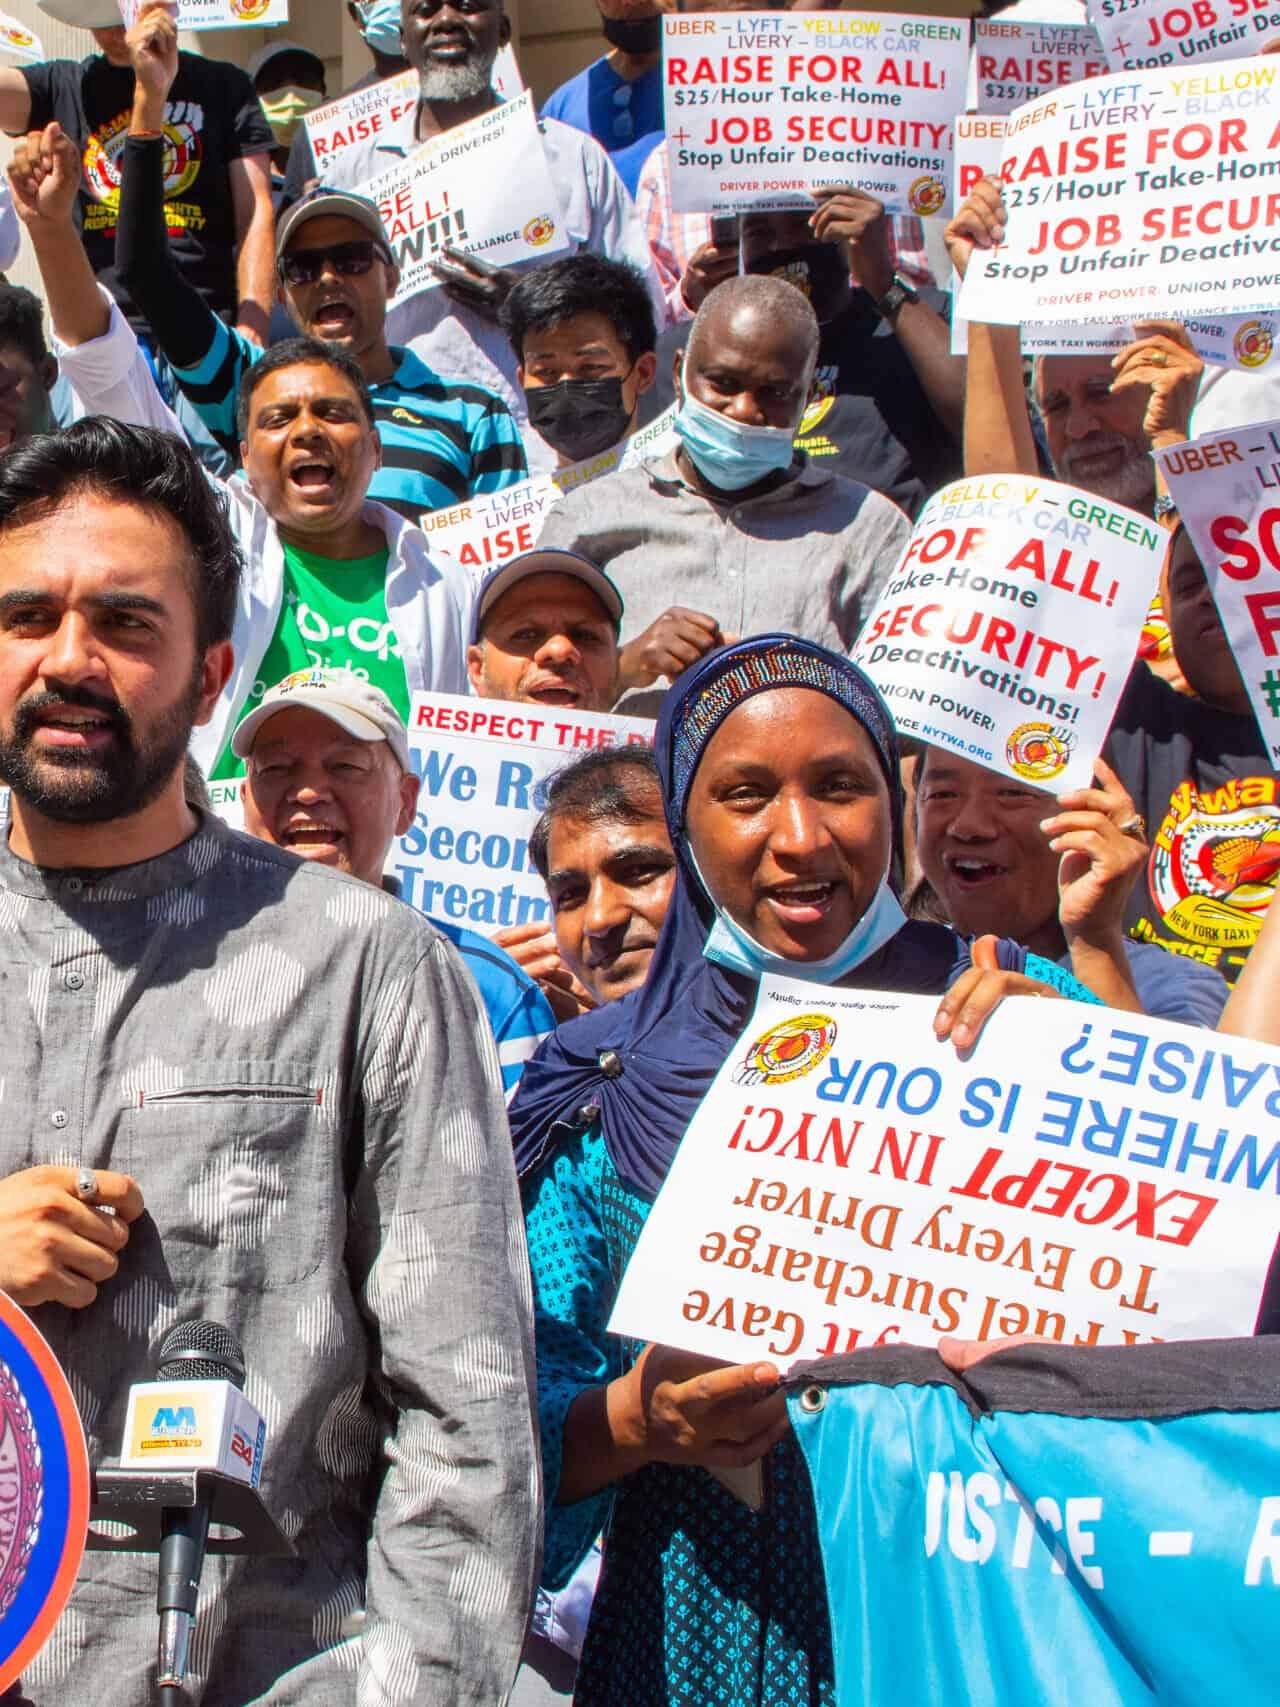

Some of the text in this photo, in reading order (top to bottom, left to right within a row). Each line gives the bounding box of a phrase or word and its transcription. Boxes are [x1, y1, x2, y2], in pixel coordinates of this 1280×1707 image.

[665, 19, 961, 40] UBER LYFT YELLOW GREEN
[977, 23, 1081, 40] UBER LYFT
[1147, 0, 1218, 47] JOB
[1179, 23, 1248, 58] Unfair
[728, 34, 920, 53] LIVERY BLACK CAR
[1032, 42, 1090, 56] LIVERY
[668, 55, 945, 90] RAISE FOR ALL!
[979, 56, 1072, 84] RAISE
[1083, 84, 1143, 108] LYFT
[1171, 67, 1278, 97] YELLOW
[307, 89, 381, 127] UBER LYFT
[347, 97, 390, 120] LIVERY
[481, 97, 527, 129] GREEN
[674, 87, 902, 106] $25/Hour Take-Home
[1070, 88, 1272, 131] LIVERY BLACK
[312, 114, 383, 157] RAISE
[704, 116, 953, 150] JOB SECURITY!
[997, 118, 1249, 185] RAISE FOR
[413, 126, 505, 183] ALL DRIVERS!
[678, 147, 945, 171] Stop Unfair Deactivations!
[720, 182, 760, 193] DRIVER
[390, 192, 450, 242] ALL!
[1028, 215, 1121, 256] JOB
[464, 230, 521, 256] ALLIANCE
[984, 250, 1150, 283] Stop Unfair
[1168, 280, 1226, 294] UNION
[1061, 339, 1085, 347] TAXI
[423, 413, 677, 532] UBER LYFT GREEN
[1163, 440, 1244, 476] UBER
[485, 497, 545, 528] LIVERY
[1033, 510, 1093, 546] CAR
[1068, 499, 1160, 551] GREEN
[886, 567, 1039, 608] Take-Home
[1006, 538, 1119, 608] ALL!
[866, 604, 1106, 699] SECURITY!
[869, 644, 1080, 724] Deactivations!
[417, 705, 616, 751] RESPECT THE
[929, 694, 995, 732] POWER!
[922, 725, 992, 761] NYTWA.ORG
[409, 747, 477, 802] We
[1170, 910, 1250, 939] NEW YORK TAXI
[767, 991, 802, 1006] Dignity.
[816, 1056, 1280, 1196] WHERE IS OUR
[726, 1105, 1219, 1247] EXCEPT IN NYC!
[733, 1177, 1161, 1315] To Every Driver
[699, 1225, 968, 1333] Surcharge
[681, 1288, 806, 1356] Gave
